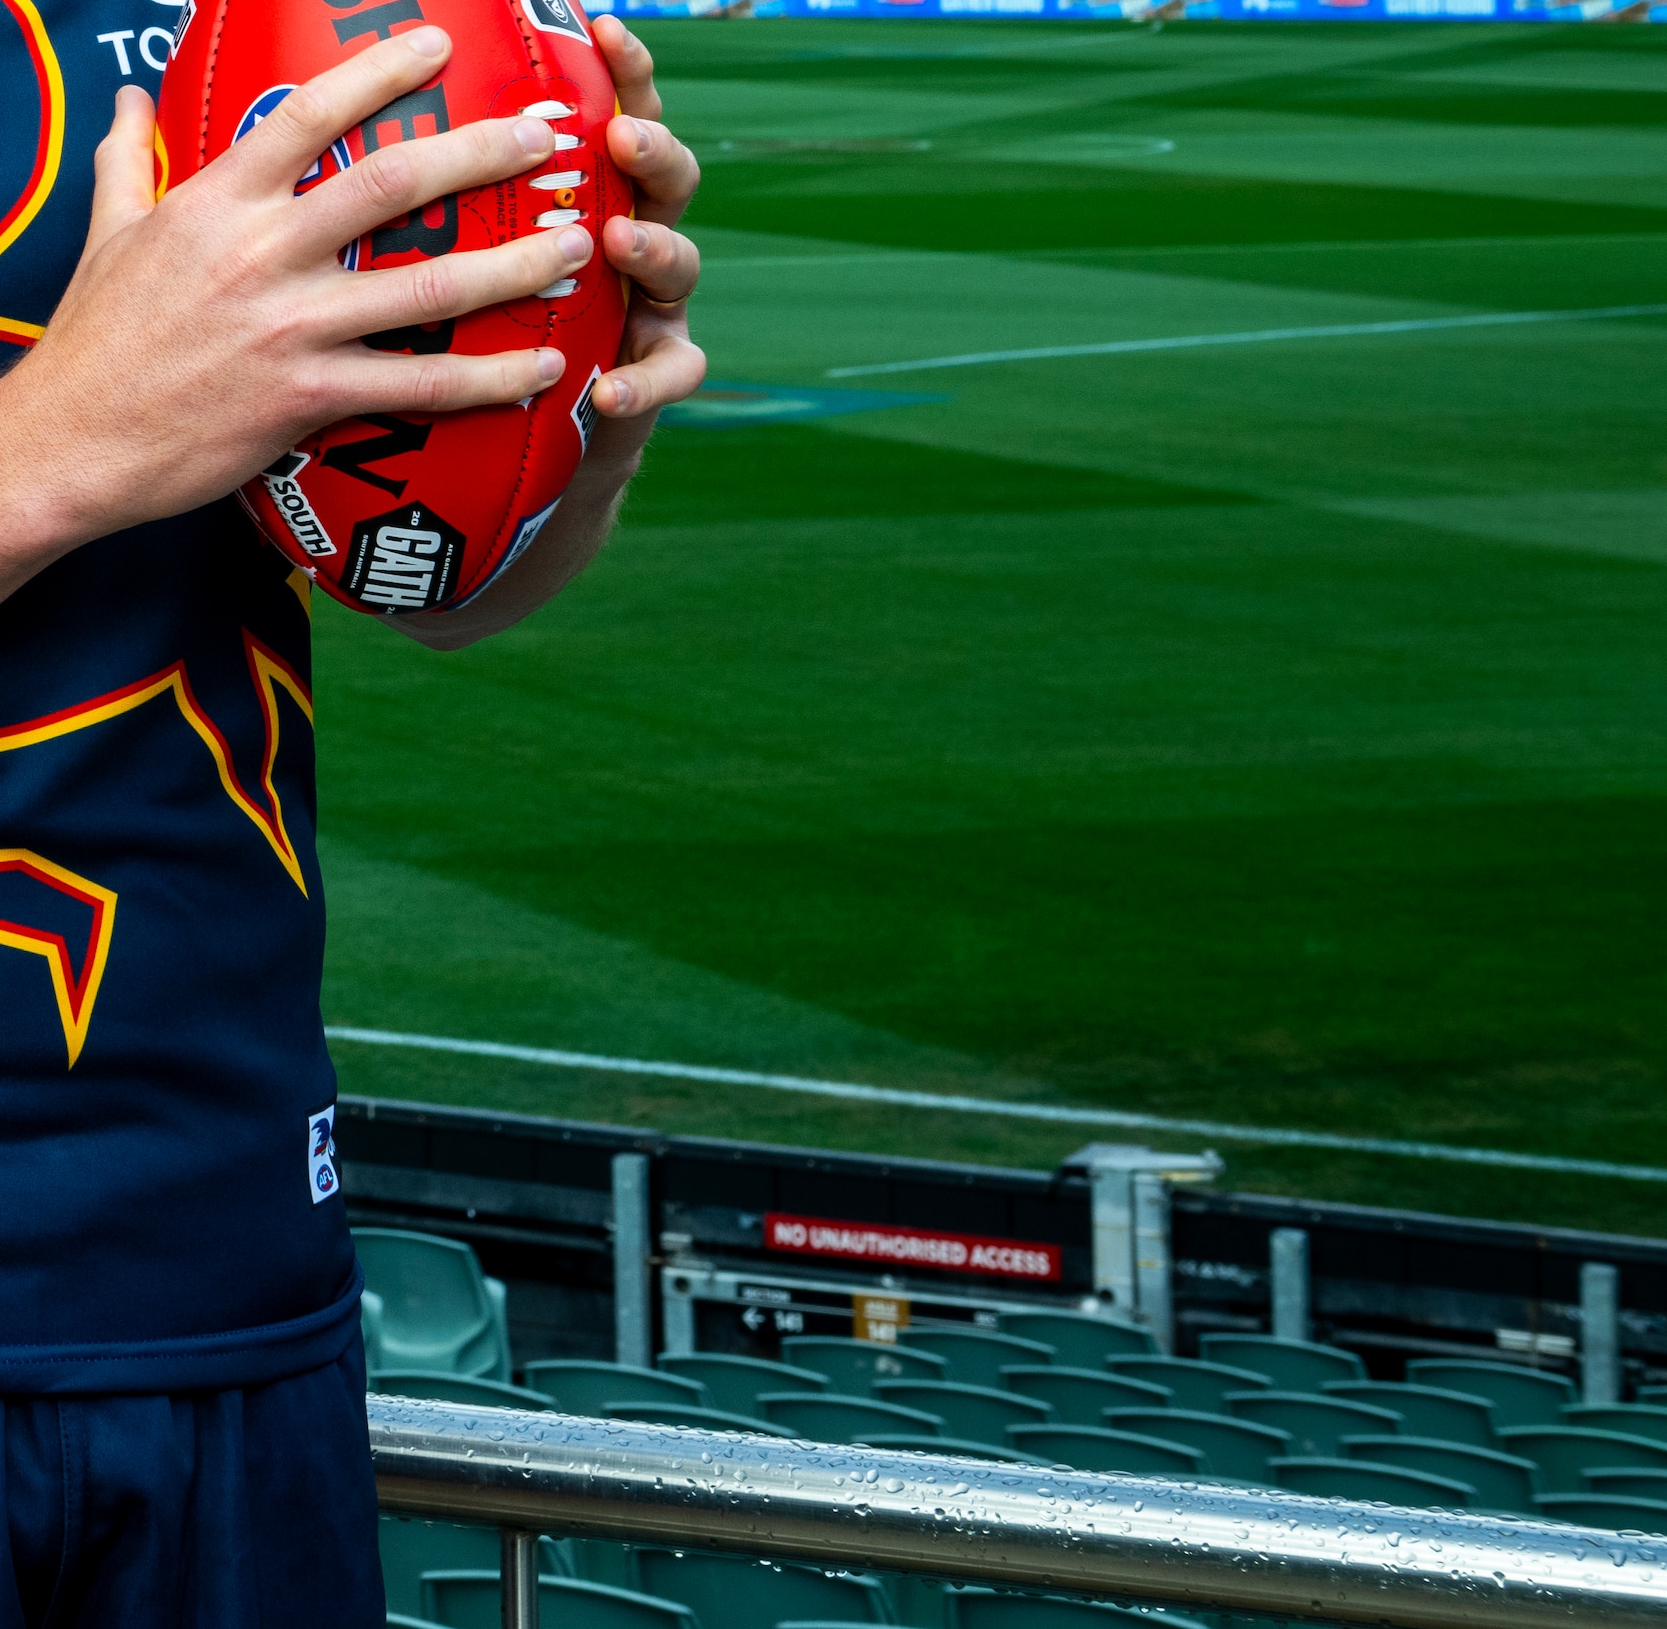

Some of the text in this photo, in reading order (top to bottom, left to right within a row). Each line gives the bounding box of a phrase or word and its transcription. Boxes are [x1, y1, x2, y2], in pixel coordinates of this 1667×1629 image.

[272, 480, 332, 554] SOUTH
[360, 526, 442, 608] GATH
[318, 1170, 333, 1188] AFL
[774, 1221, 1051, 1275] NO UNAUTHORISED ACCESS
